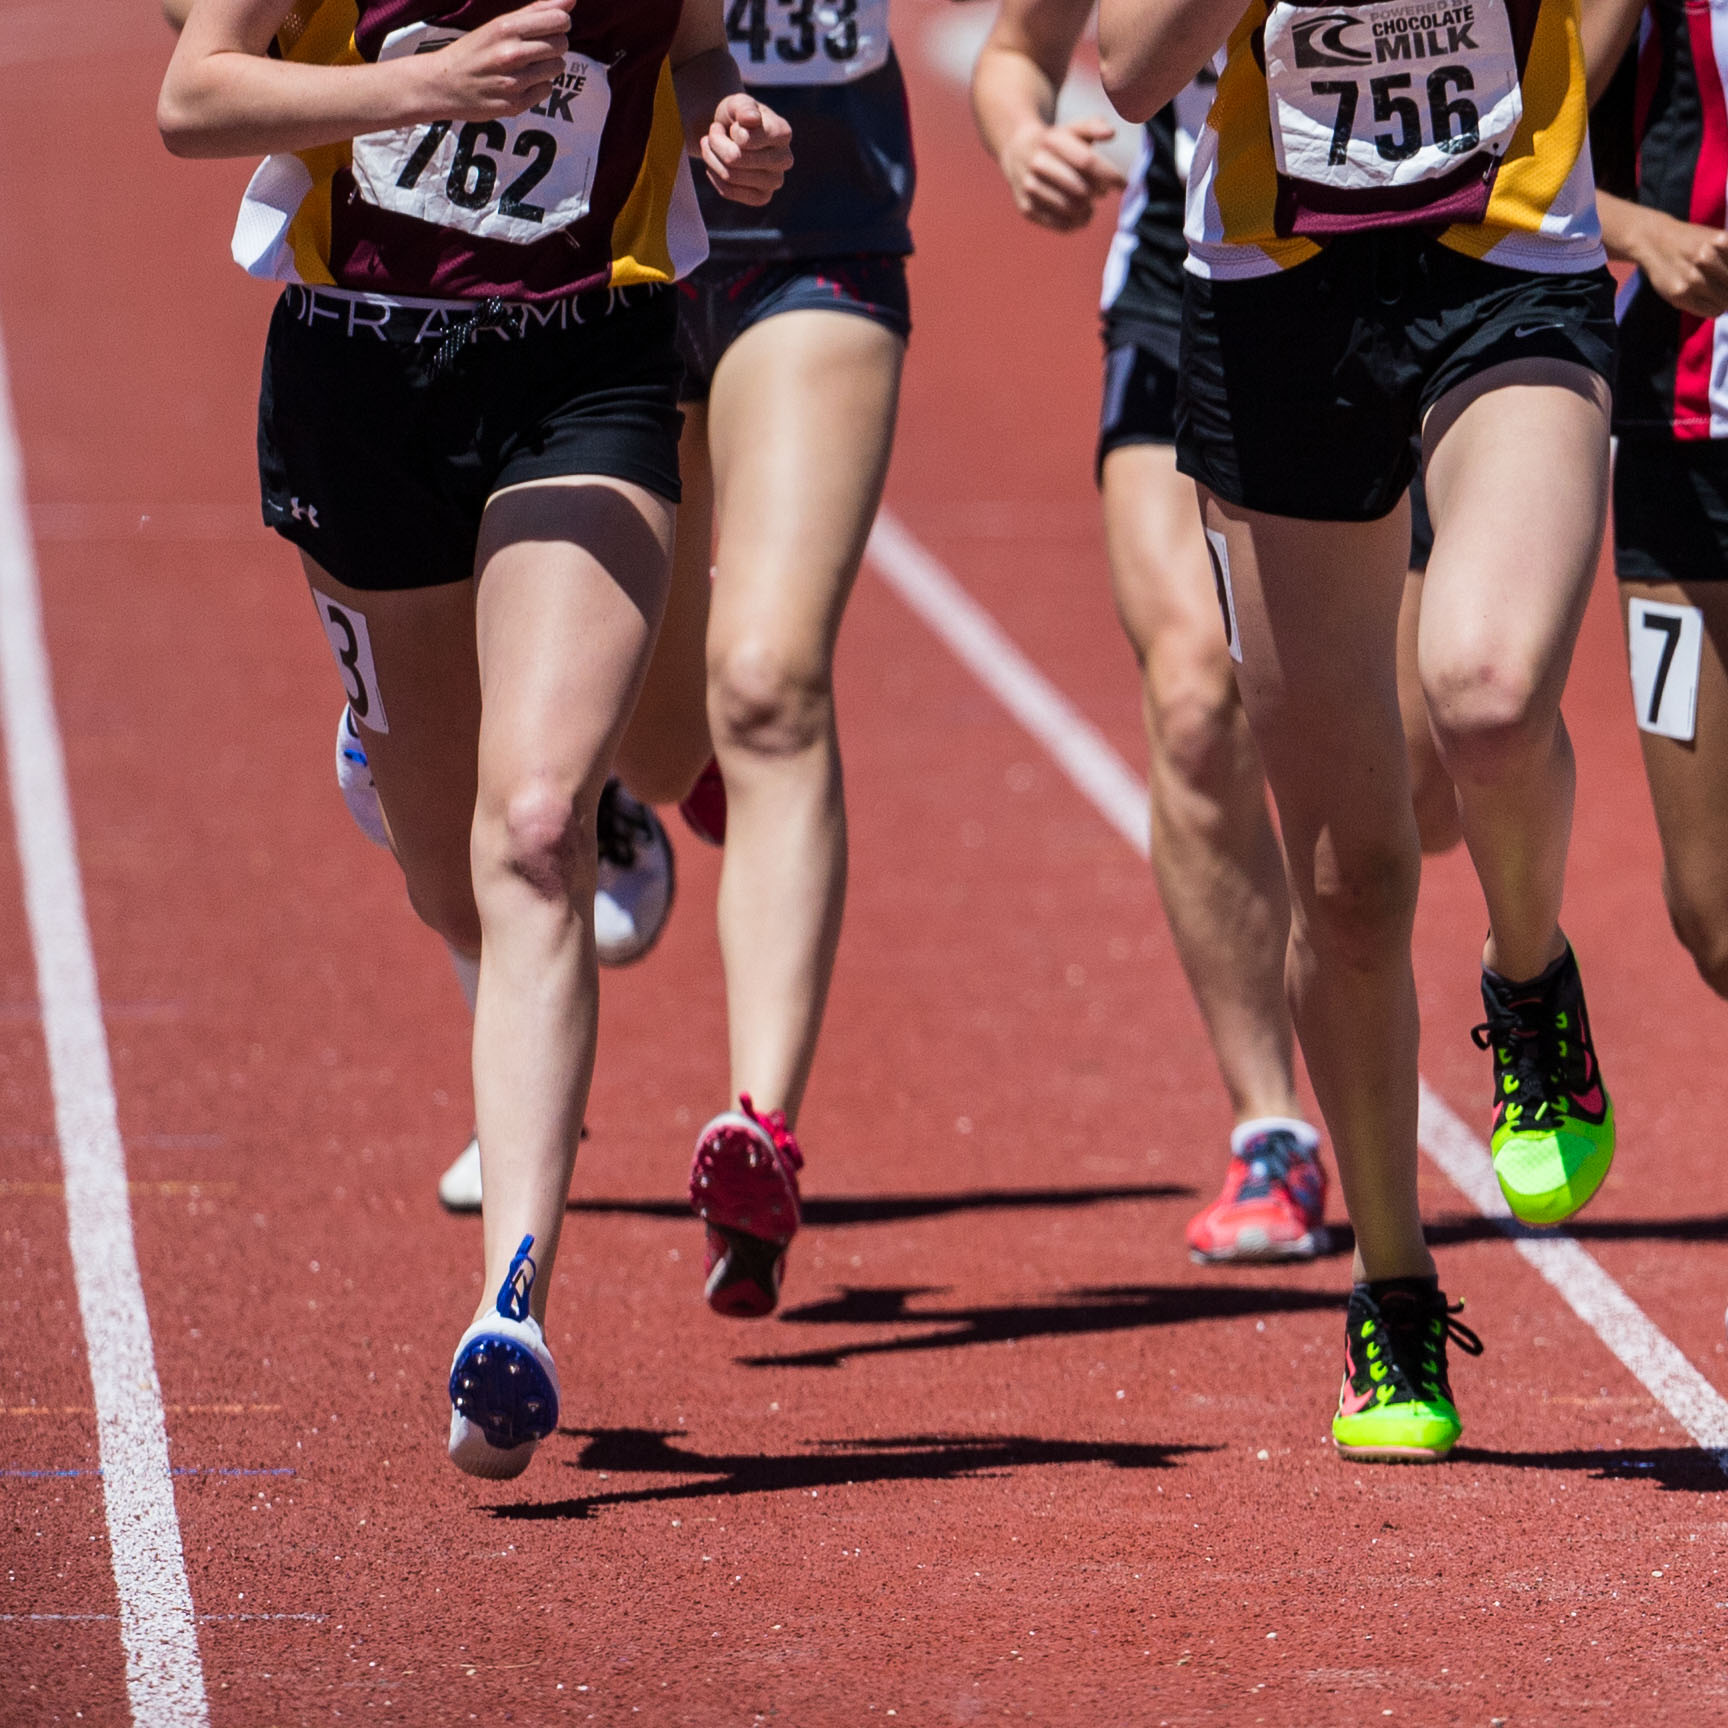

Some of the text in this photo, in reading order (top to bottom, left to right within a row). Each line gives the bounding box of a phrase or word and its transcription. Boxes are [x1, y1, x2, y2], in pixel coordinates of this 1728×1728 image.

[1370, 0, 1448, 22] POWERED
[1372, 5, 1475, 37] CHOCOLATE
[1375, 22, 1480, 64] MILK
[1310, 65, 1480, 167] 756
[396, 119, 558, 223] 762
[327, 604, 370, 718] 3
[1643, 610, 1683, 725] 7
